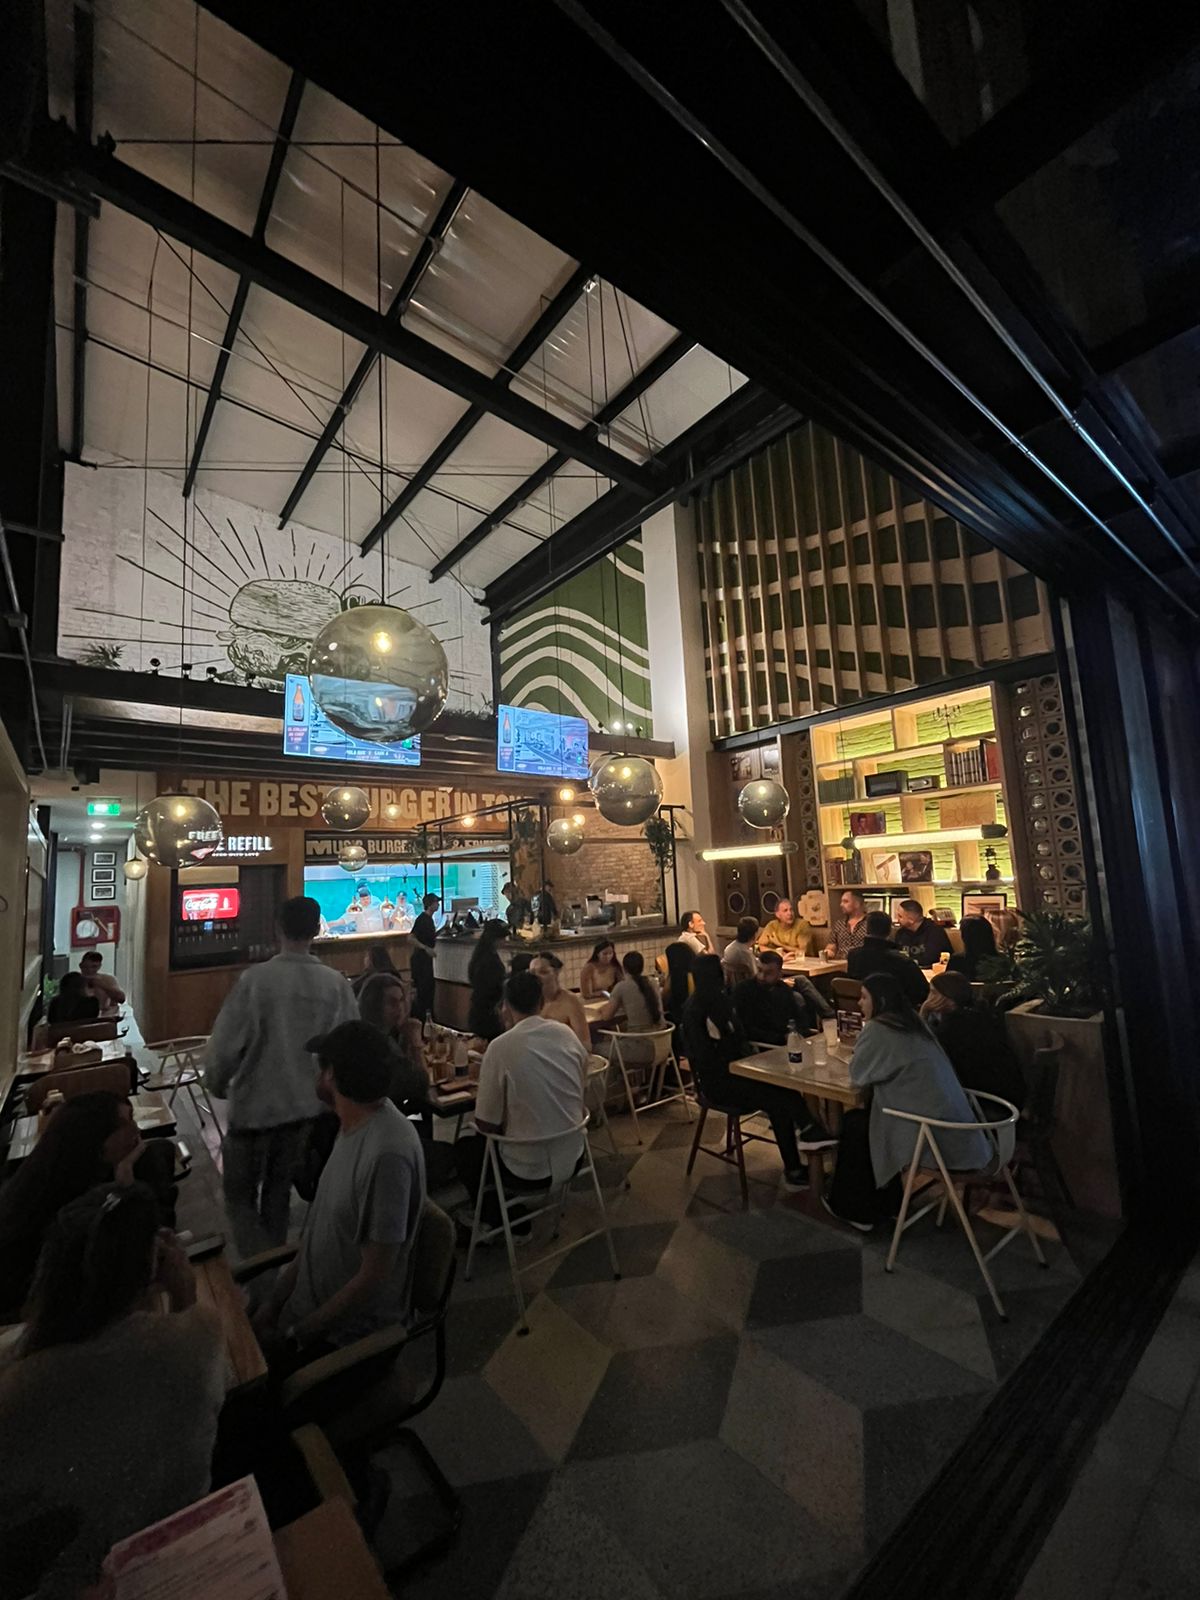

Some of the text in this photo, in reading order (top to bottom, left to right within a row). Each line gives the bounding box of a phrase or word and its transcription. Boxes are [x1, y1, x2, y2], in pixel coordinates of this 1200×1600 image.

[182, 780, 250, 816] THE
[351, 787, 451, 820] URGER
[454, 792, 477, 818] IN
[481, 793, 541, 822] TO
[227, 836, 273, 851] REFILL
